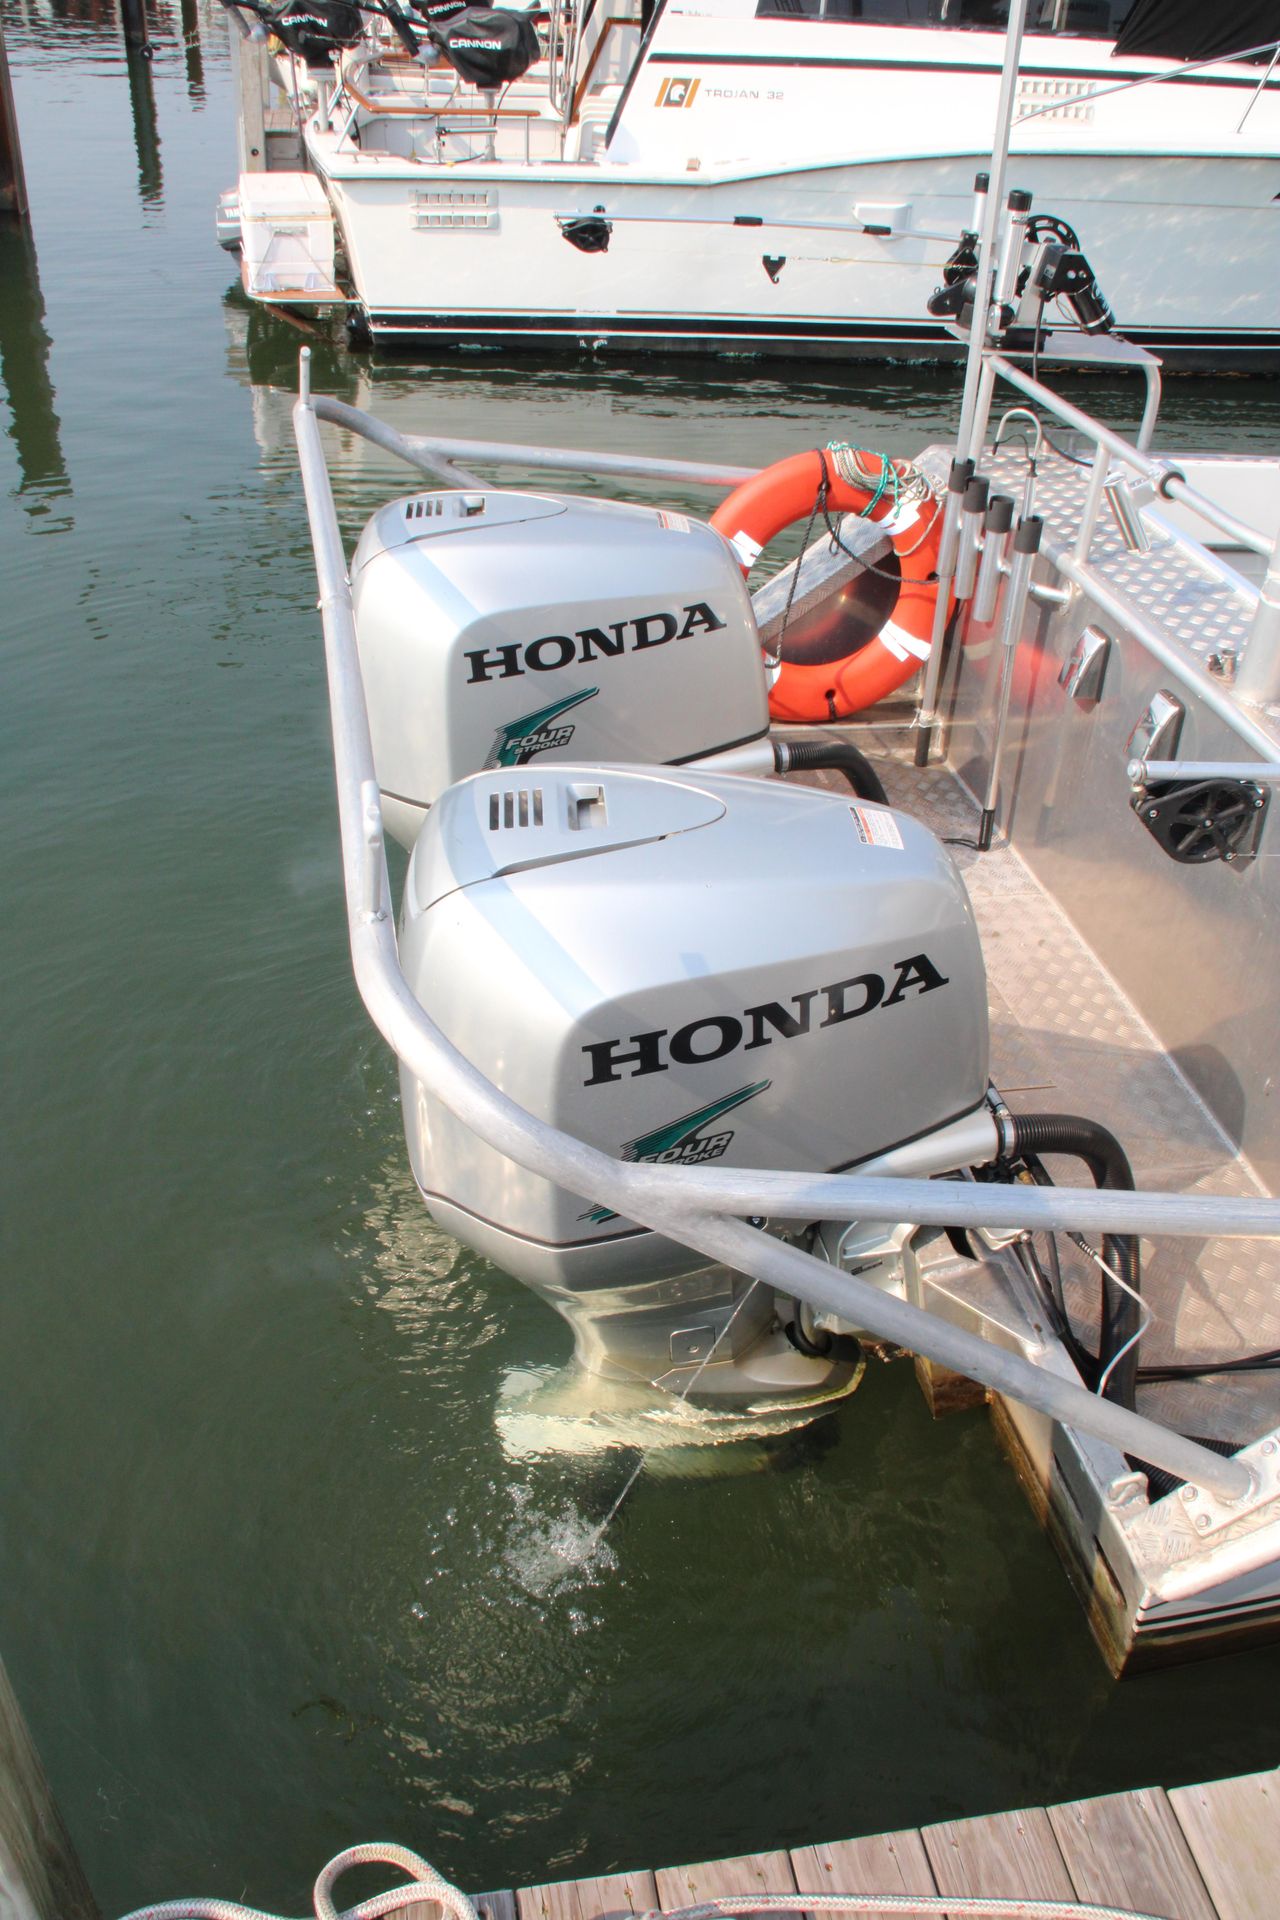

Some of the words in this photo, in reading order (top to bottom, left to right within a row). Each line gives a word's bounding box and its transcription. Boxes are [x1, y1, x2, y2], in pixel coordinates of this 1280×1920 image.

[427, 1, 467, 15] CANNON
[449, 38, 502, 50] CANNON
[704, 89, 759, 99] TROJAN
[767, 90, 785, 100] 32
[464, 602, 727, 684] HONDA
[505, 726, 574, 751] FOUR
[514, 738, 569, 754] STROKE
[581, 953, 950, 1087] HONDA
[638, 1133, 730, 1164] FOUR
[671, 1147, 725, 1165] ROKE
